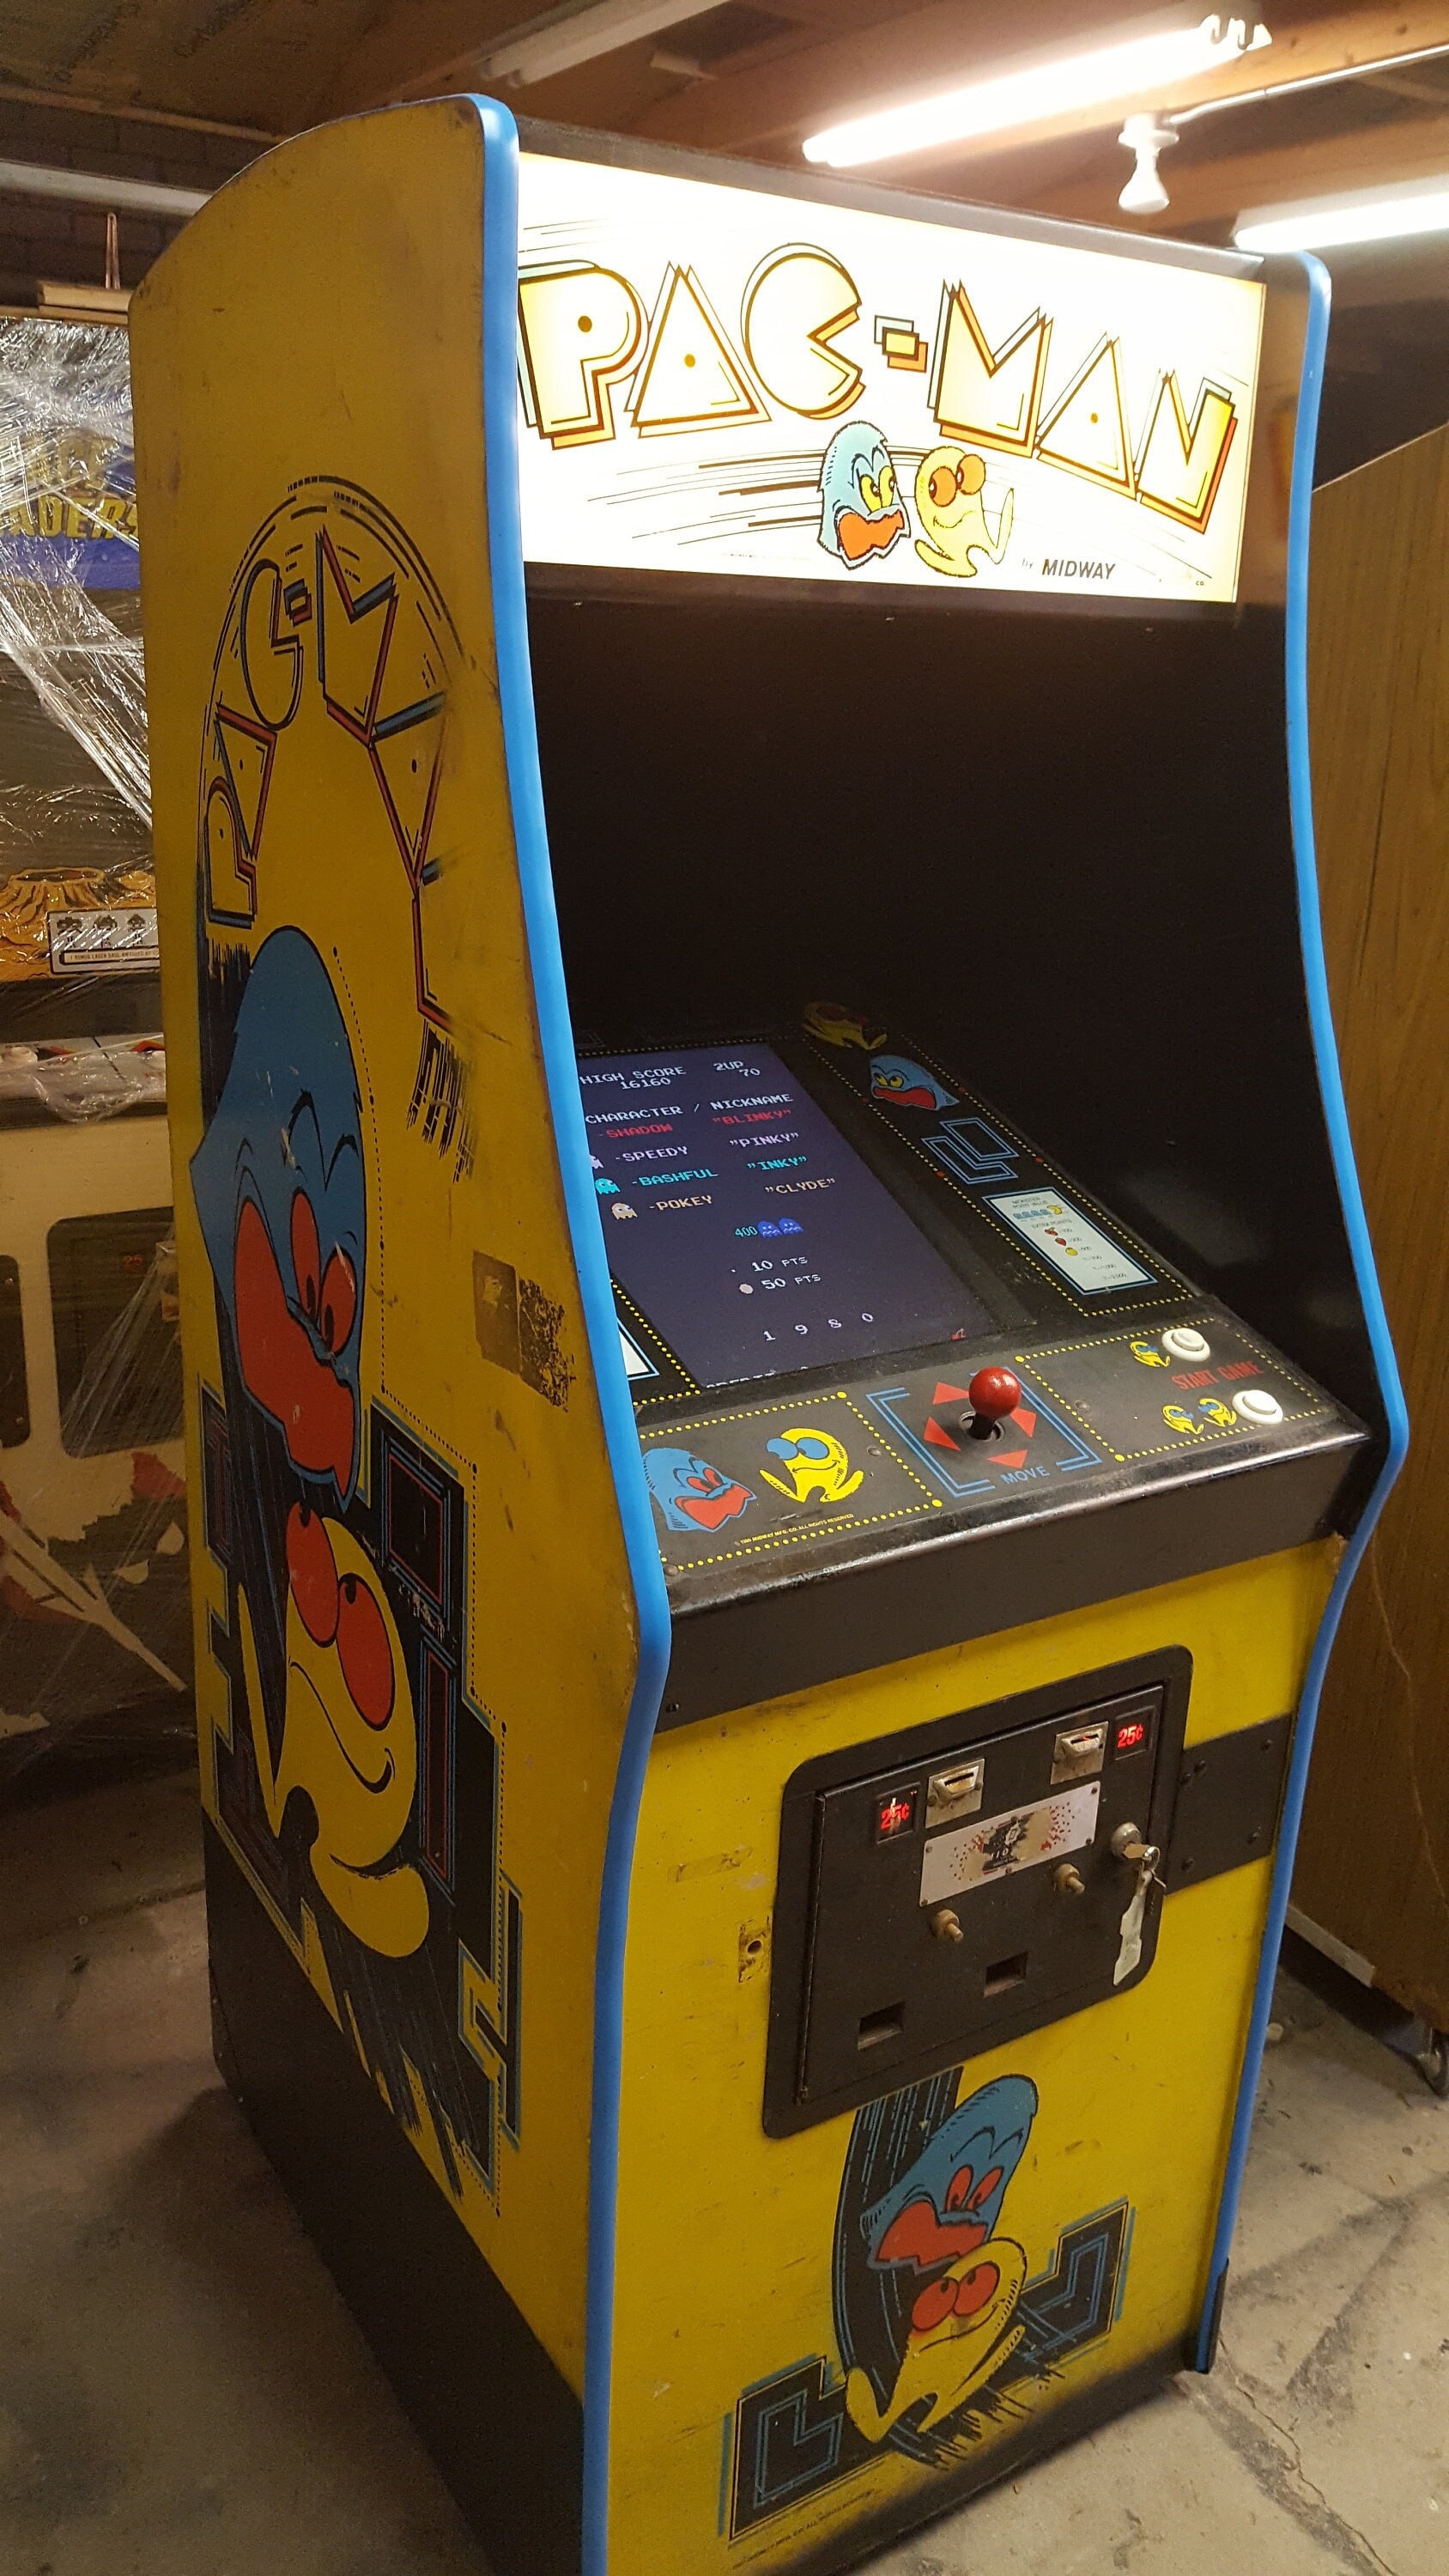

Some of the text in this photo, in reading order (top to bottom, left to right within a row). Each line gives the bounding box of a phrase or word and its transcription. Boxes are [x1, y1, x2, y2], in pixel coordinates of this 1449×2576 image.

[518, 243, 1239, 534] PAC-MAN
[1022, 557, 1116, 580] by MIDWAY
[714, 1060, 744, 1072] 2UP
[739, 1067, 761, 1078] 70
[579, 1066, 687, 1085] HIGH SCORE
[621, 1078, 671, 1090] 16160
[585, 1092, 793, 1124] CHARACTER / NICKNAME
[734, 1225, 758, 1237] 400
[752, 1256, 809, 1272] 10 PTS
[761, 1273, 822, 1290] 50 PTS
[1171, 1360, 1264, 1390] START GAME
[1001, 1462, 1051, 1487] MOVE
[752, 1531, 774, 1543] MIDWAY
[1117, 1723, 1144, 1748] 25¢
